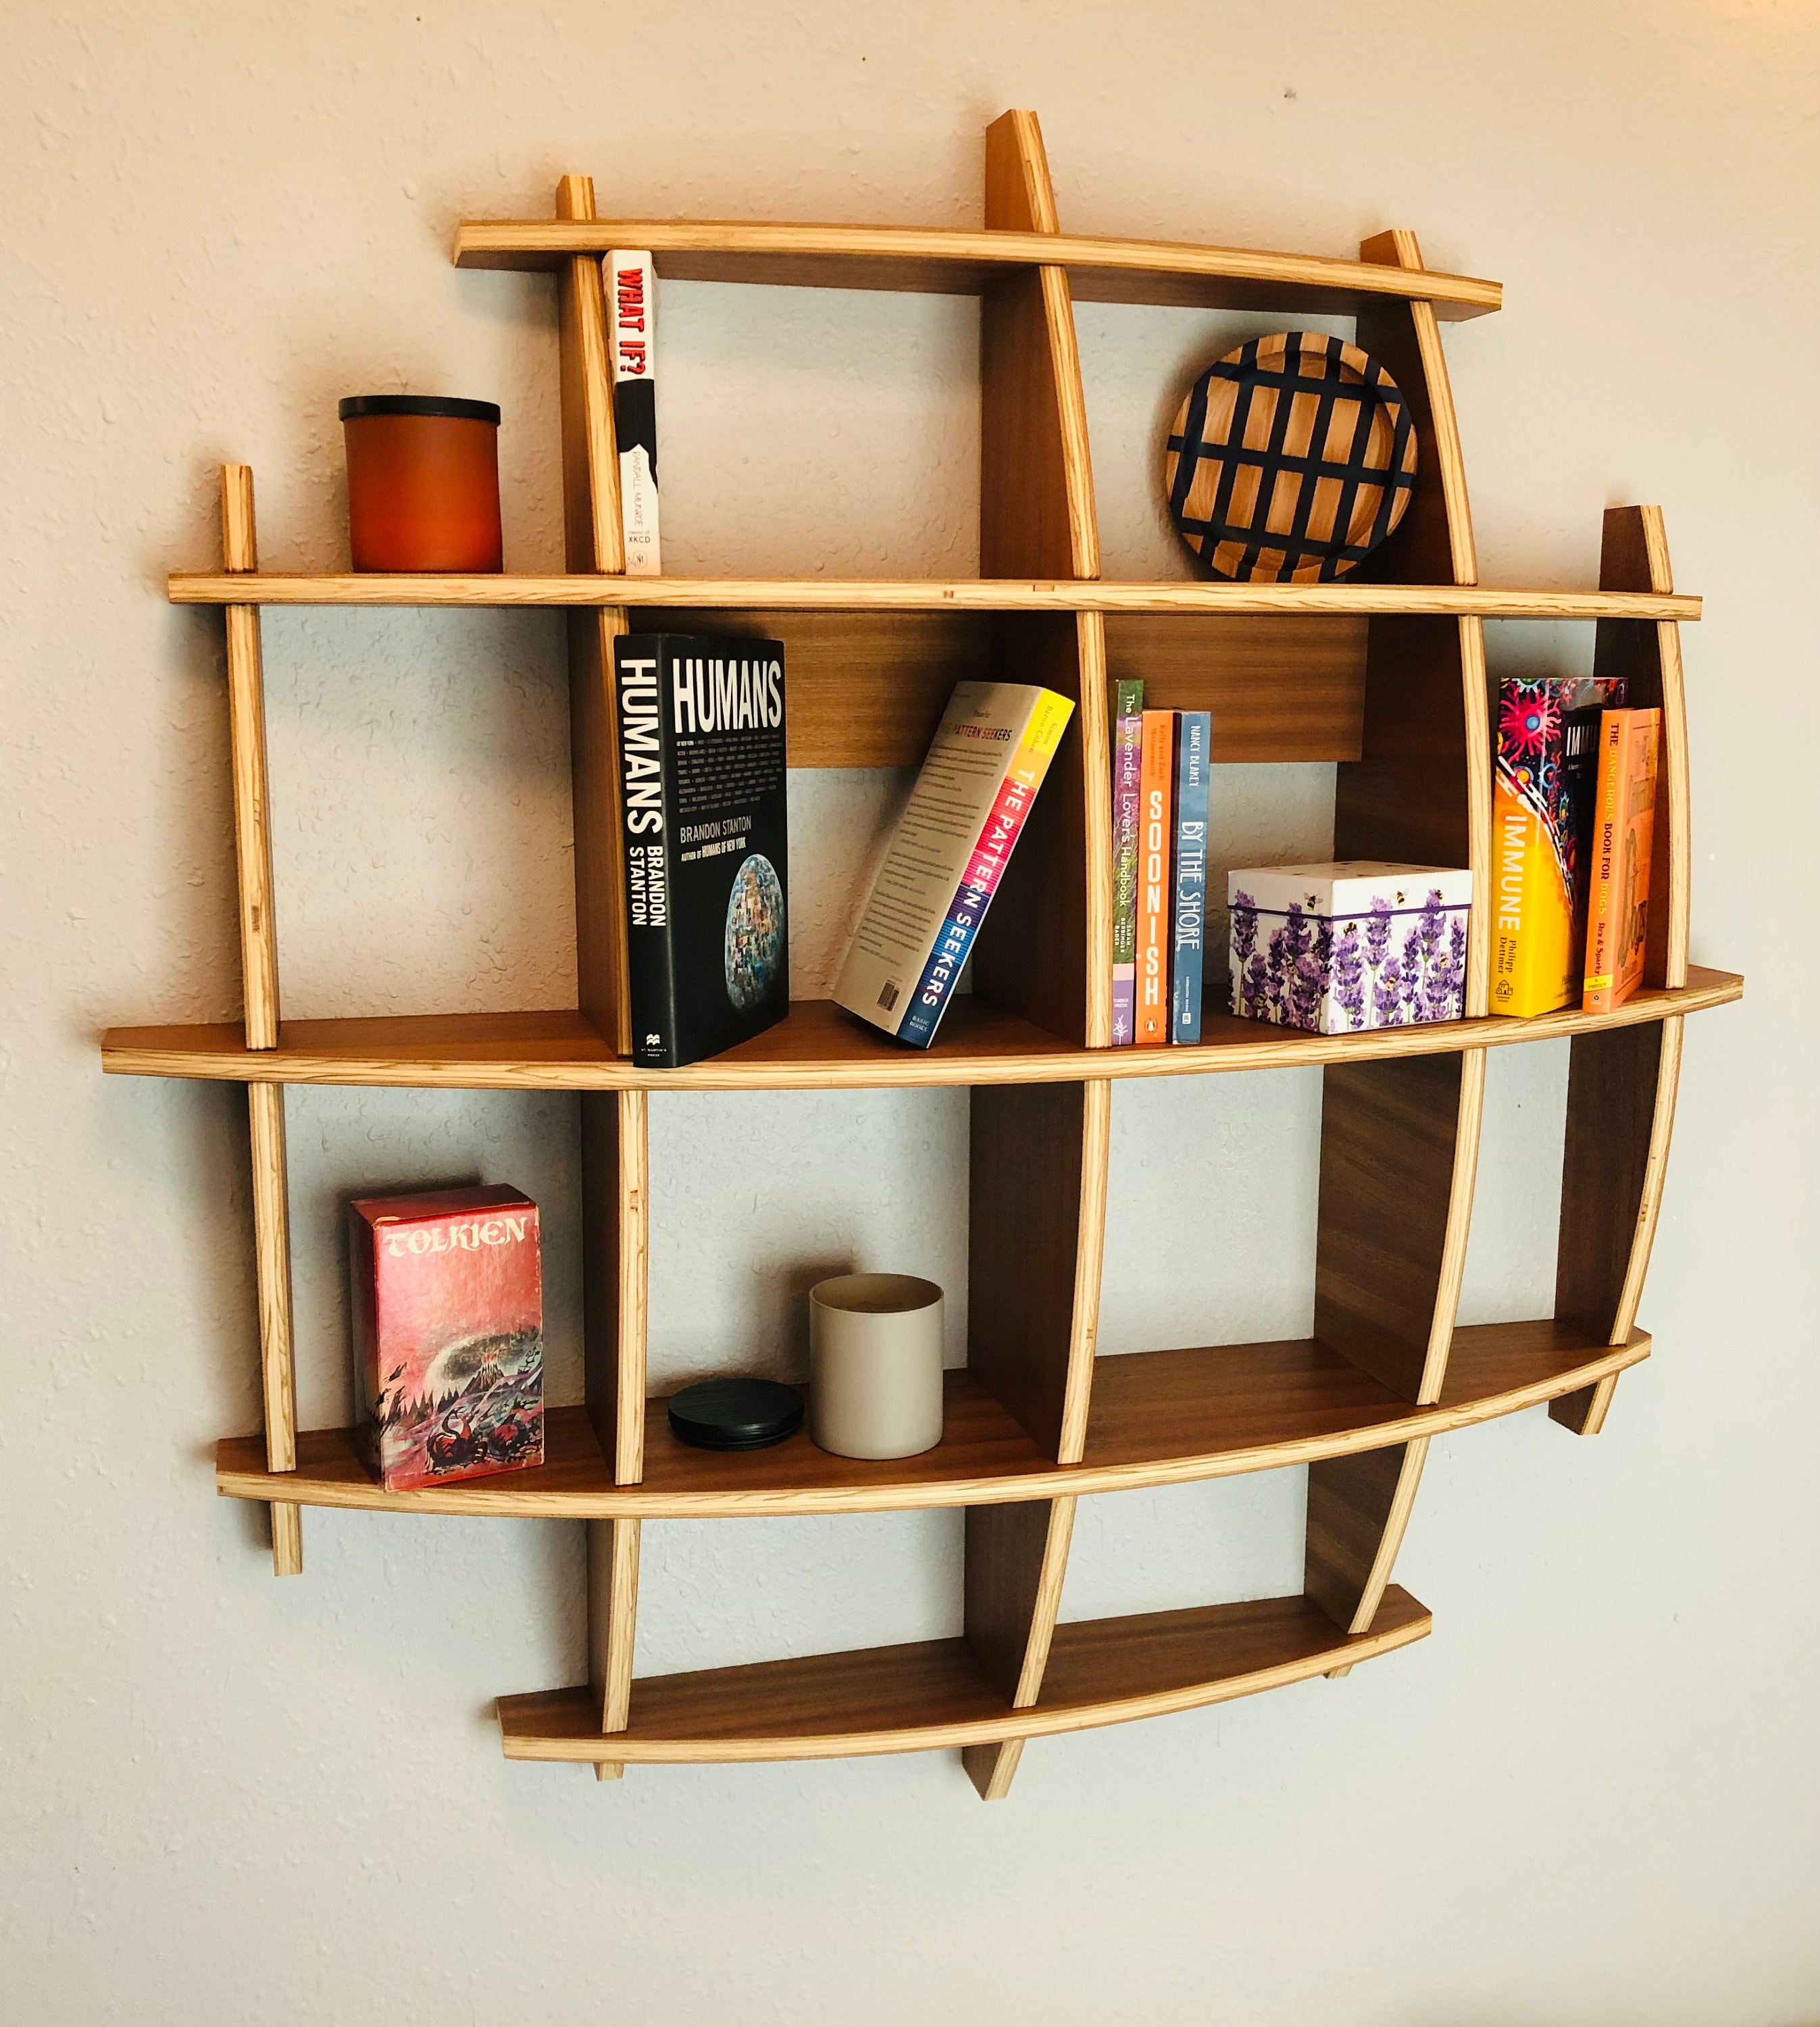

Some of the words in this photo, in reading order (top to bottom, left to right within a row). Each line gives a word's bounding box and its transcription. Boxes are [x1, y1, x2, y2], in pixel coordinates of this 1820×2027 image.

[617, 268, 644, 332] WHAT
[620, 341, 645, 374] IF?
[632, 451, 642, 488] RANDALL
[634, 493, 643, 526] MUNROE
[673, 659, 782, 733] HUMANS
[1126, 694, 1135, 714] The
[621, 659, 663, 834] HUMANS
[982, 728, 1012, 741] SEEKERS
[1043, 722, 1058, 745] Simon
[1190, 726, 1200, 752] NANCY
[1610, 723, 1619, 746] THE
[1123, 717, 1138, 787] Lavender
[1188, 755, 1200, 787] BLAKEY
[1604, 750, 1617, 820] DANGEROUS
[1005, 770, 1035, 811] THE
[680, 822, 720, 843] BRANDON
[722, 816, 752, 835] STANTON
[1182, 822, 1204, 843] BY
[1603, 823, 1613, 854] BOOK
[702, 843, 721, 857] HUMANS
[726, 839, 736, 851] NEW
[736, 836, 746, 849] YORK
[963, 815, 1015, 909] PATTERN
[1119, 847, 1131, 907] Handbook
[1180, 849, 1203, 883] THE
[1498, 816, 1527, 931] IMMUNE
[1601, 857, 1611, 880] FOR
[630, 847, 647, 925] STANTON
[647, 846, 666, 926] BRANDON
[1145, 790, 1163, 1005] SOONISH
[1598, 883, 1609, 914] DOGS
[1178, 890, 1201, 950] SHORE
[1597, 922, 1605, 937] Rex
[922, 912, 971, 1007] SEEKERS
[1498, 937, 1507, 974] Dettmer
[1505, 940, 1517, 973] Philipp
[1594, 948, 1604, 974] Sparky
[909, 1021, 928, 1032] BOOKS
[912, 1016, 930, 1026] BASIC
[382, 1217, 528, 1257] TOLKIEN
